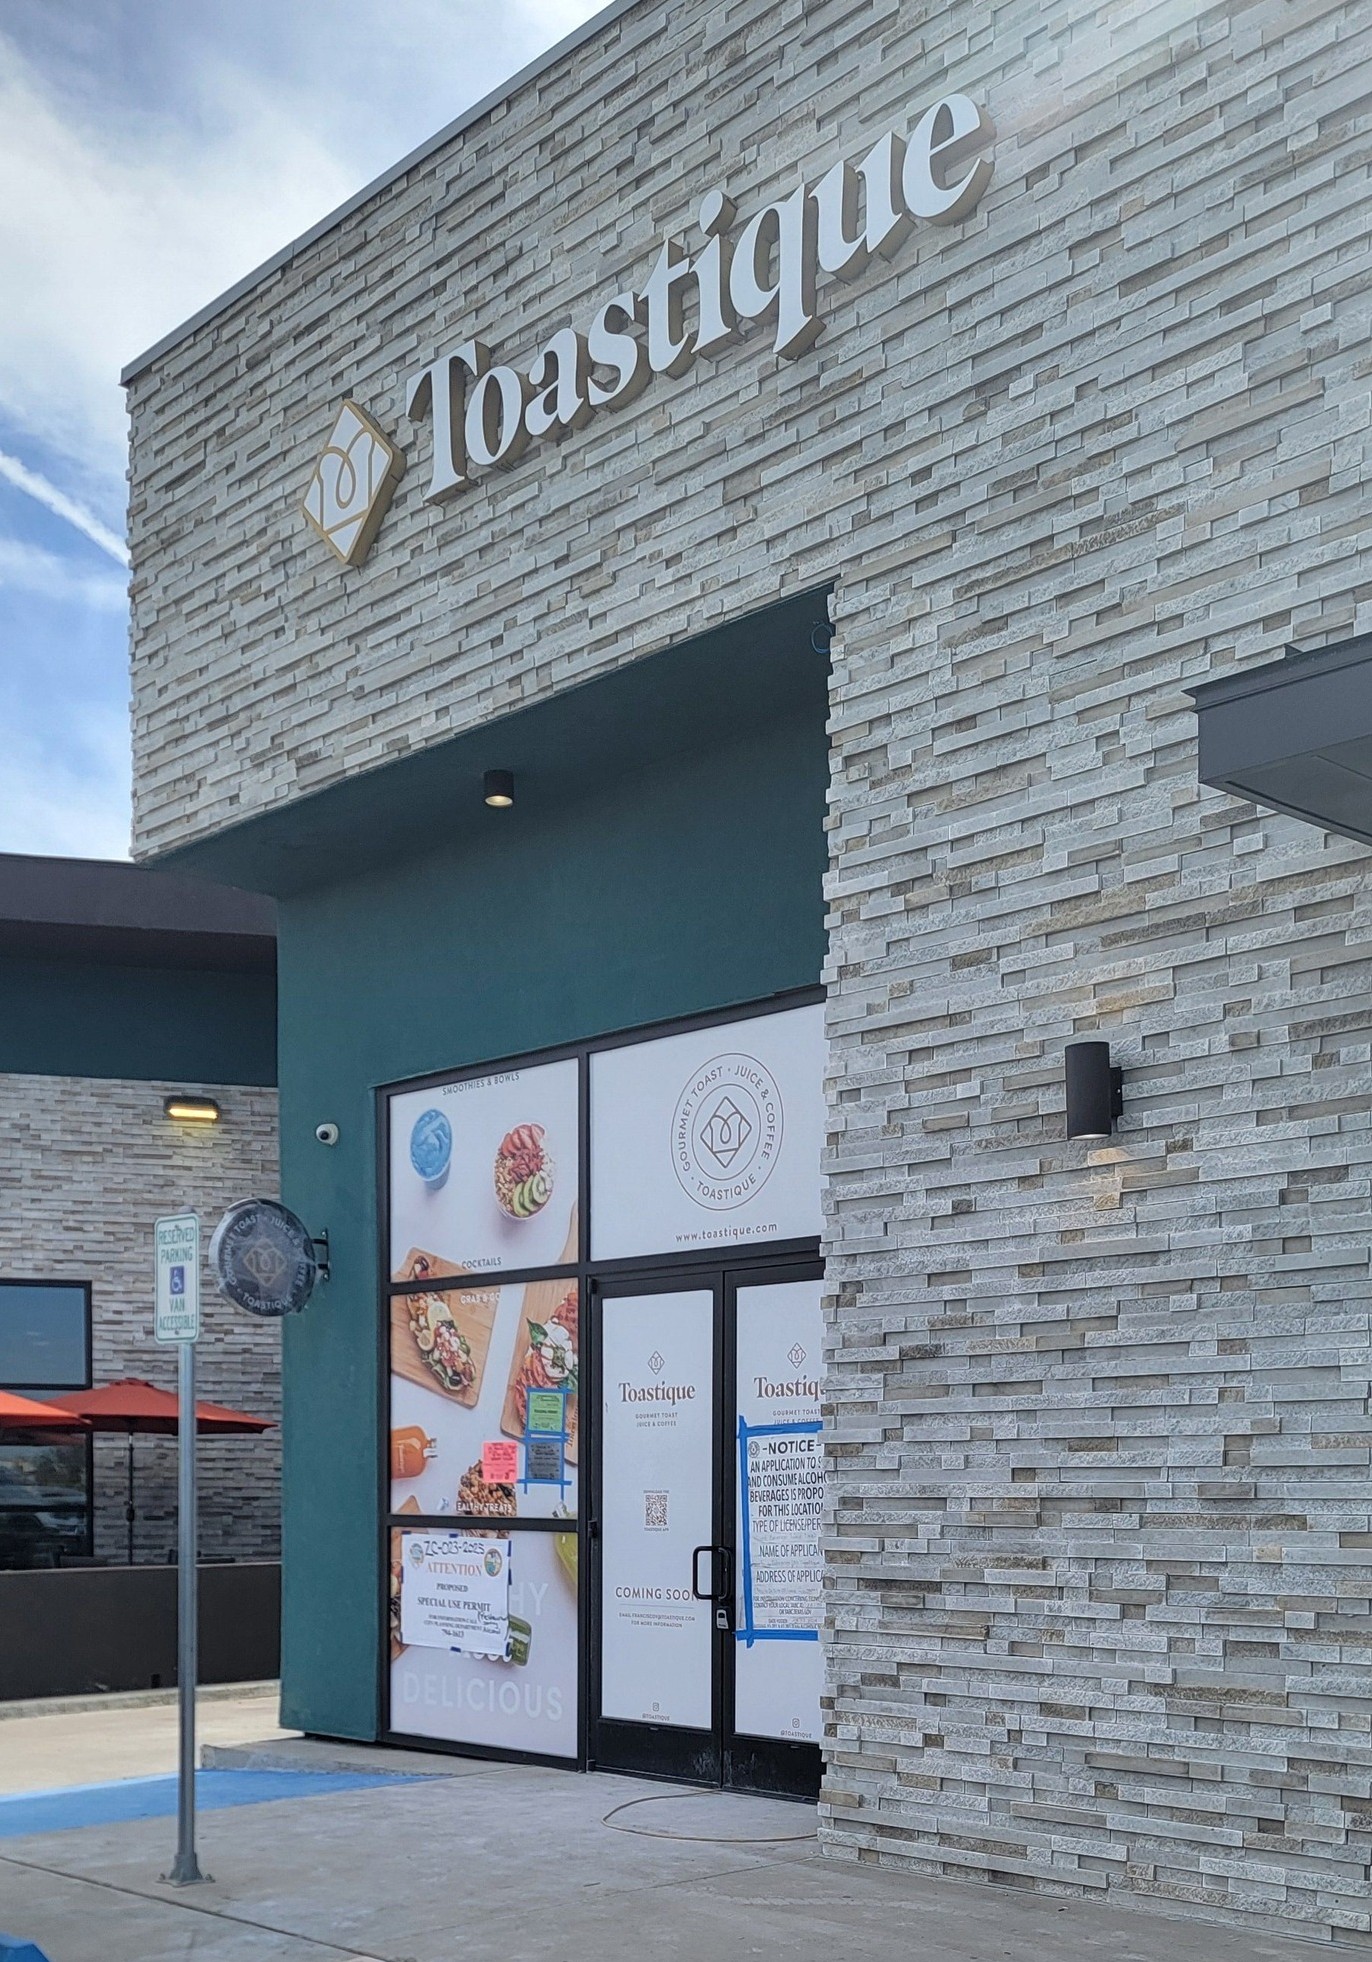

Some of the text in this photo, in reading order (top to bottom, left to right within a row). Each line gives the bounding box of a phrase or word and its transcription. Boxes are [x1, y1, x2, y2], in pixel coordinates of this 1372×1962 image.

[406, 93, 997, 503] Toastique
[442, 1072, 520, 1096] SMOOTHIES & BOWLS
[678, 1065, 776, 1172] GOURMET TOAST JUICE & COFFEE
[696, 1173, 757, 1201] TOASTIQUE
[233, 1213, 261, 1234] TOAST
[270, 1215, 296, 1238] JUICE
[675, 1222, 778, 1242] www.toastique.com
[158, 1227, 195, 1246] RESERVED
[160, 1247, 193, 1264] PARKING
[461, 1257, 502, 1269] COCKTAILS
[169, 1298, 185, 1312] VAN
[242, 1292, 294, 1311] TOASTIQUE
[460, 1295, 480, 1304] GRAB
[158, 1314, 195, 1331] ACCESSIBLE
[618, 1381, 695, 1406] Toastique
[754, 1375, 826, 1402] Toastiq
[750, 1461, 760, 1473] AN
[761, 1458, 805, 1473] APPLICATION
[807, 1456, 816, 1469] TO
[748, 1475, 761, 1488] AND
[763, 1473, 797, 1487] CONSUME
[750, 1488, 790, 1503] BEVERAGES
[791, 1488, 797, 1501] IS
[485, 1503, 512, 1513] TREATS
[758, 1505, 773, 1517] FOR
[774, 1503, 790, 1516] THIS
[753, 1520, 767, 1533] TYPE
[769, 1519, 779, 1532] OF
[760, 1544, 779, 1558] NAME
[780, 1544, 789, 1557] OF
[427, 1561, 482, 1577] ATTENTION
[756, 1570, 787, 1583] ADDRESS
[787, 1570, 796, 1582] OF
[436, 1582, 468, 1593] PROPOSED
[615, 1587, 662, 1600] COMING
[417, 1597, 491, 1612] SPECIAL USE PERMIT
[403, 1672, 563, 1722] DELICIOUS
[642, 1713, 670, 1722] @TOASTIQUE
[780, 1729, 812, 1739] @TOASTIQUE
